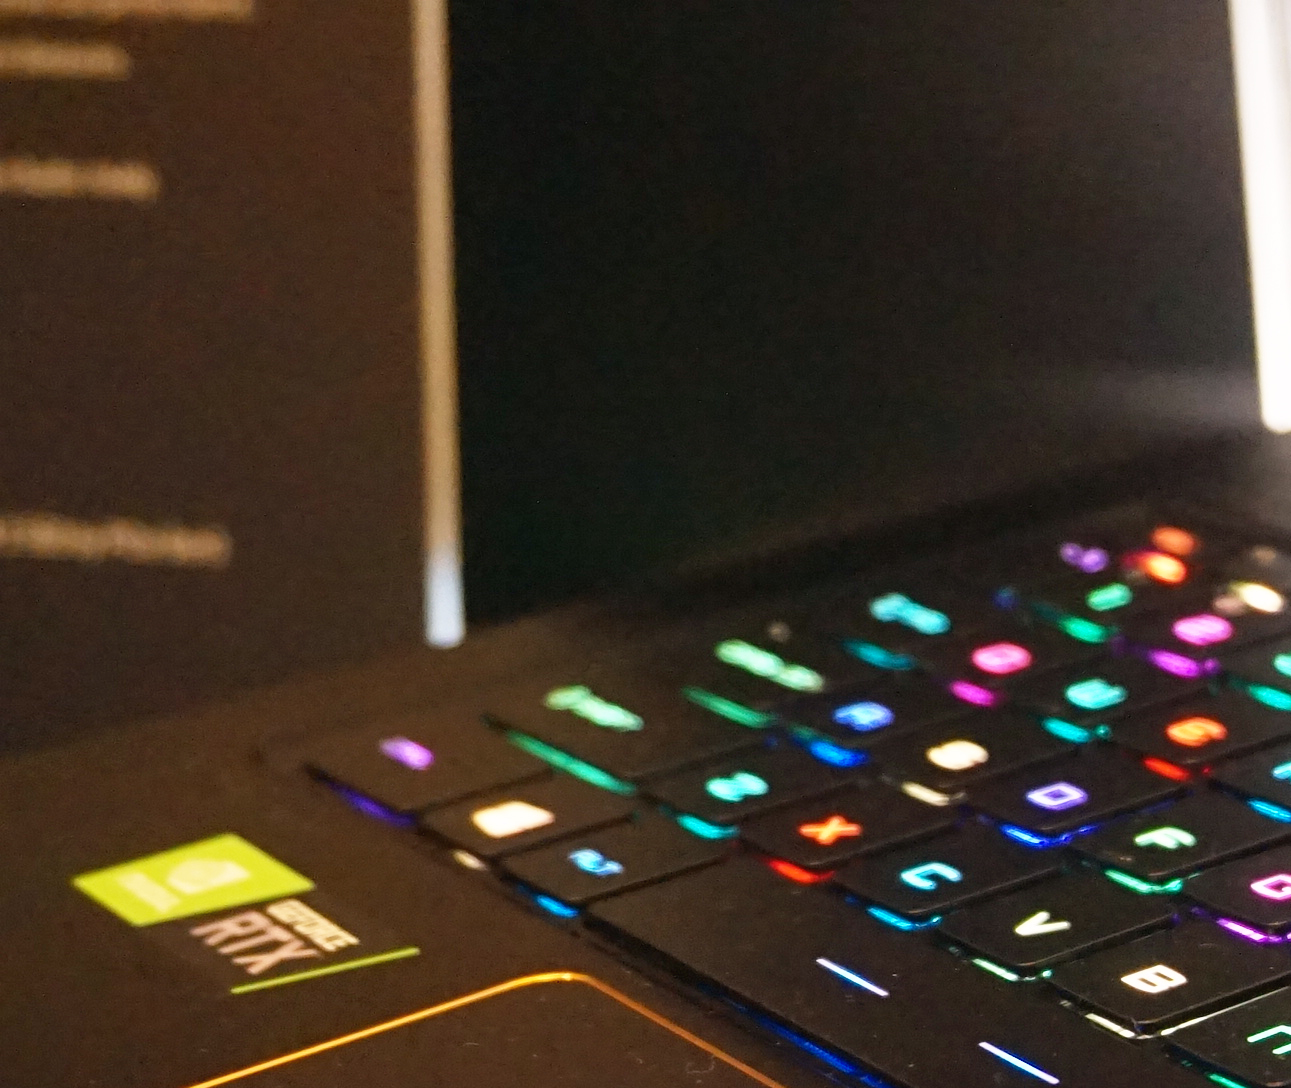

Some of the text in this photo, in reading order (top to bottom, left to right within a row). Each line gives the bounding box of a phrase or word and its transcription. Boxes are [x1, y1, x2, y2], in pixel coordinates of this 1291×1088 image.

[1024, 780, 1090, 813] D
[796, 813, 863, 847] X
[1132, 825, 1198, 851] F
[898, 860, 964, 892] C
[1012, 909, 1072, 938] V
[188, 909, 320, 975] RTX
[1118, 962, 1189, 996] B
